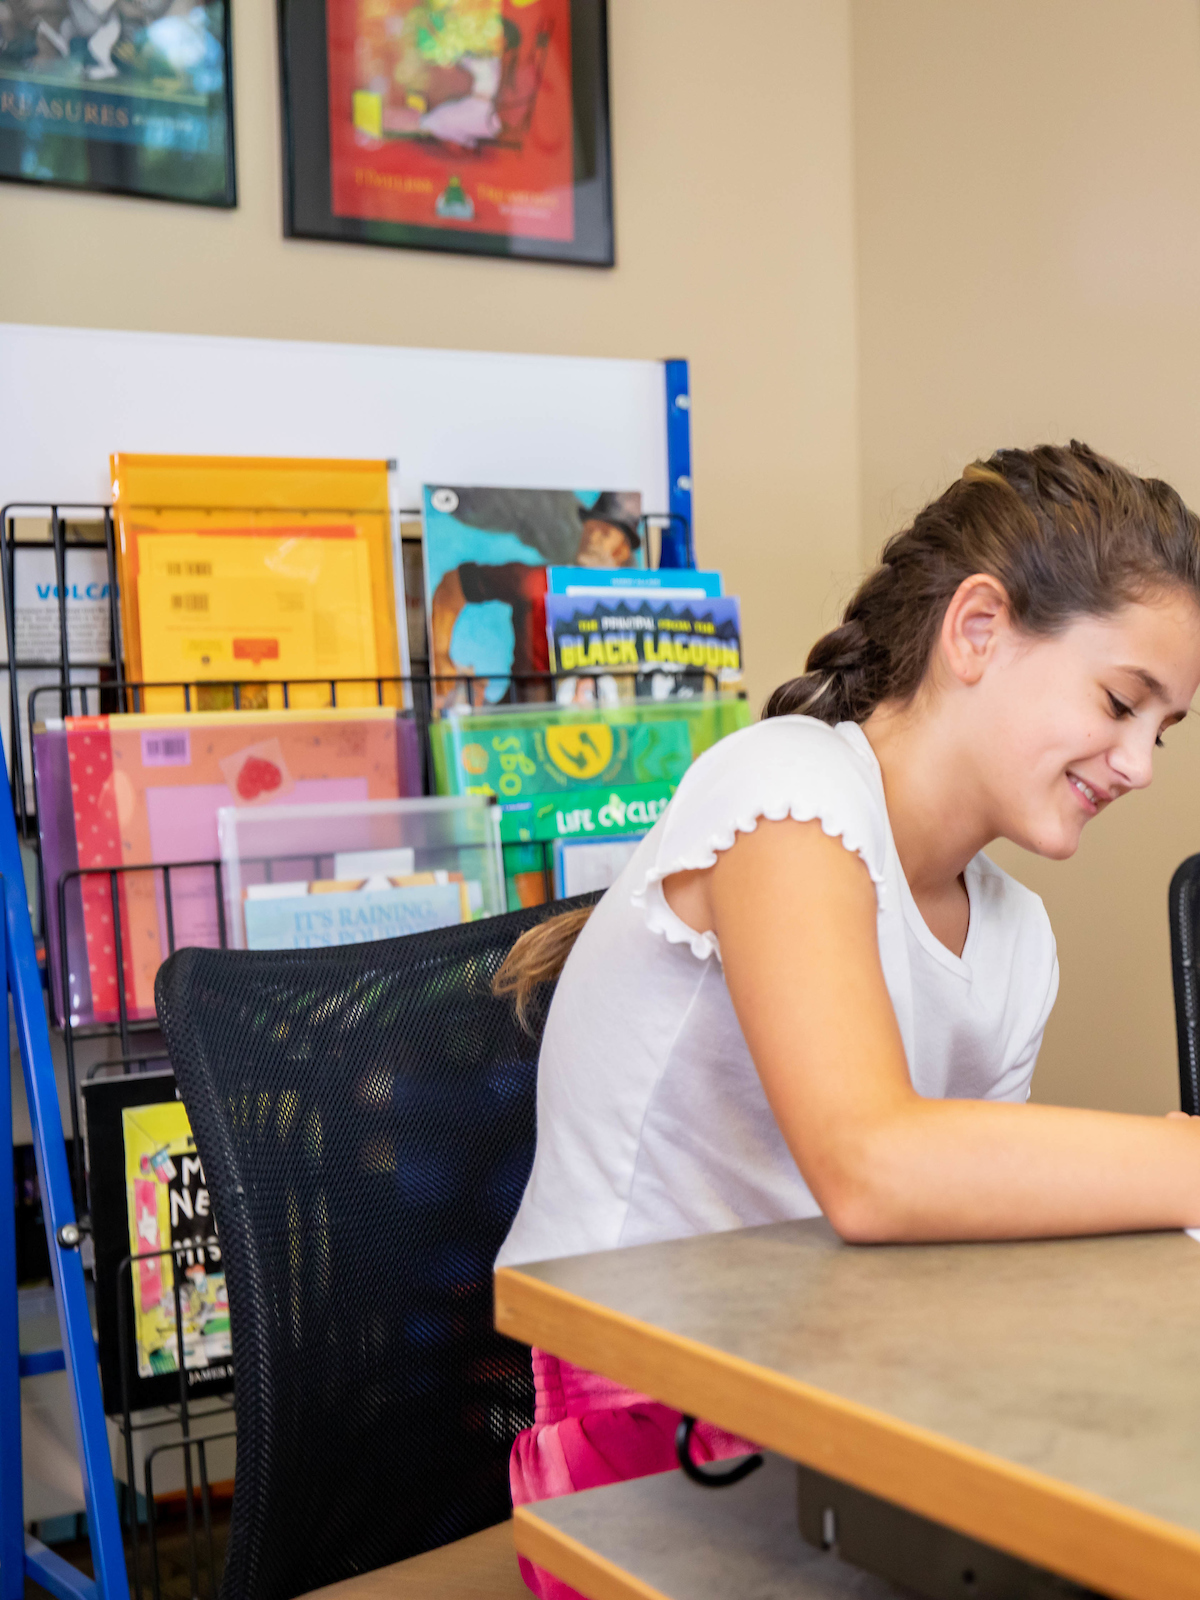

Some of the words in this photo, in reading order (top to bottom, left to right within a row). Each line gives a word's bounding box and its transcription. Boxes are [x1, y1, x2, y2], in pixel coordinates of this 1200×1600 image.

[578, 618, 598, 633] THE
[657, 618, 692, 633] FROM
[694, 620, 716, 636] THE
[559, 633, 640, 670] BLACK
[644, 632, 740, 669] LAGOON
[556, 808, 596, 834] LIFE
[295, 910, 333, 931] IT'S
[169, 1186, 217, 1231] NE
